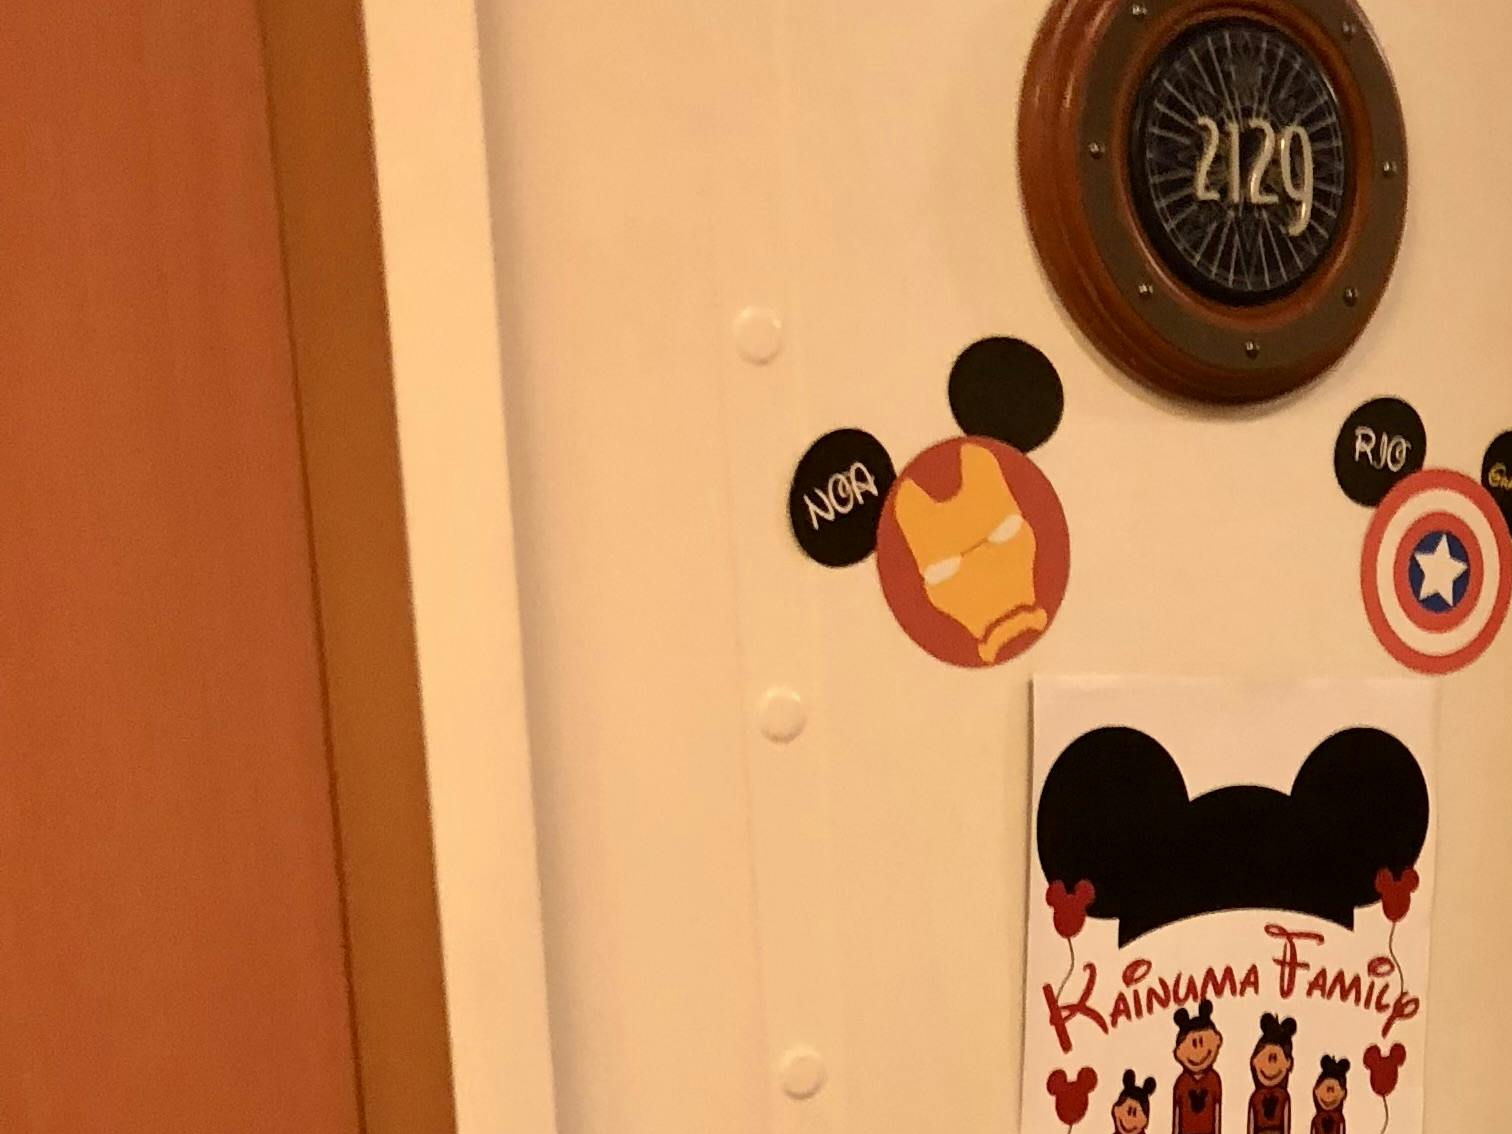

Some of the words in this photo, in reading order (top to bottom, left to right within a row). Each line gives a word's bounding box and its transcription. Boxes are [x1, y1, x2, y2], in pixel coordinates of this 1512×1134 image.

[1194, 117, 1314, 237] 2129
[1354, 426, 1411, 472] RIO
[803, 461, 879, 530] NOA
